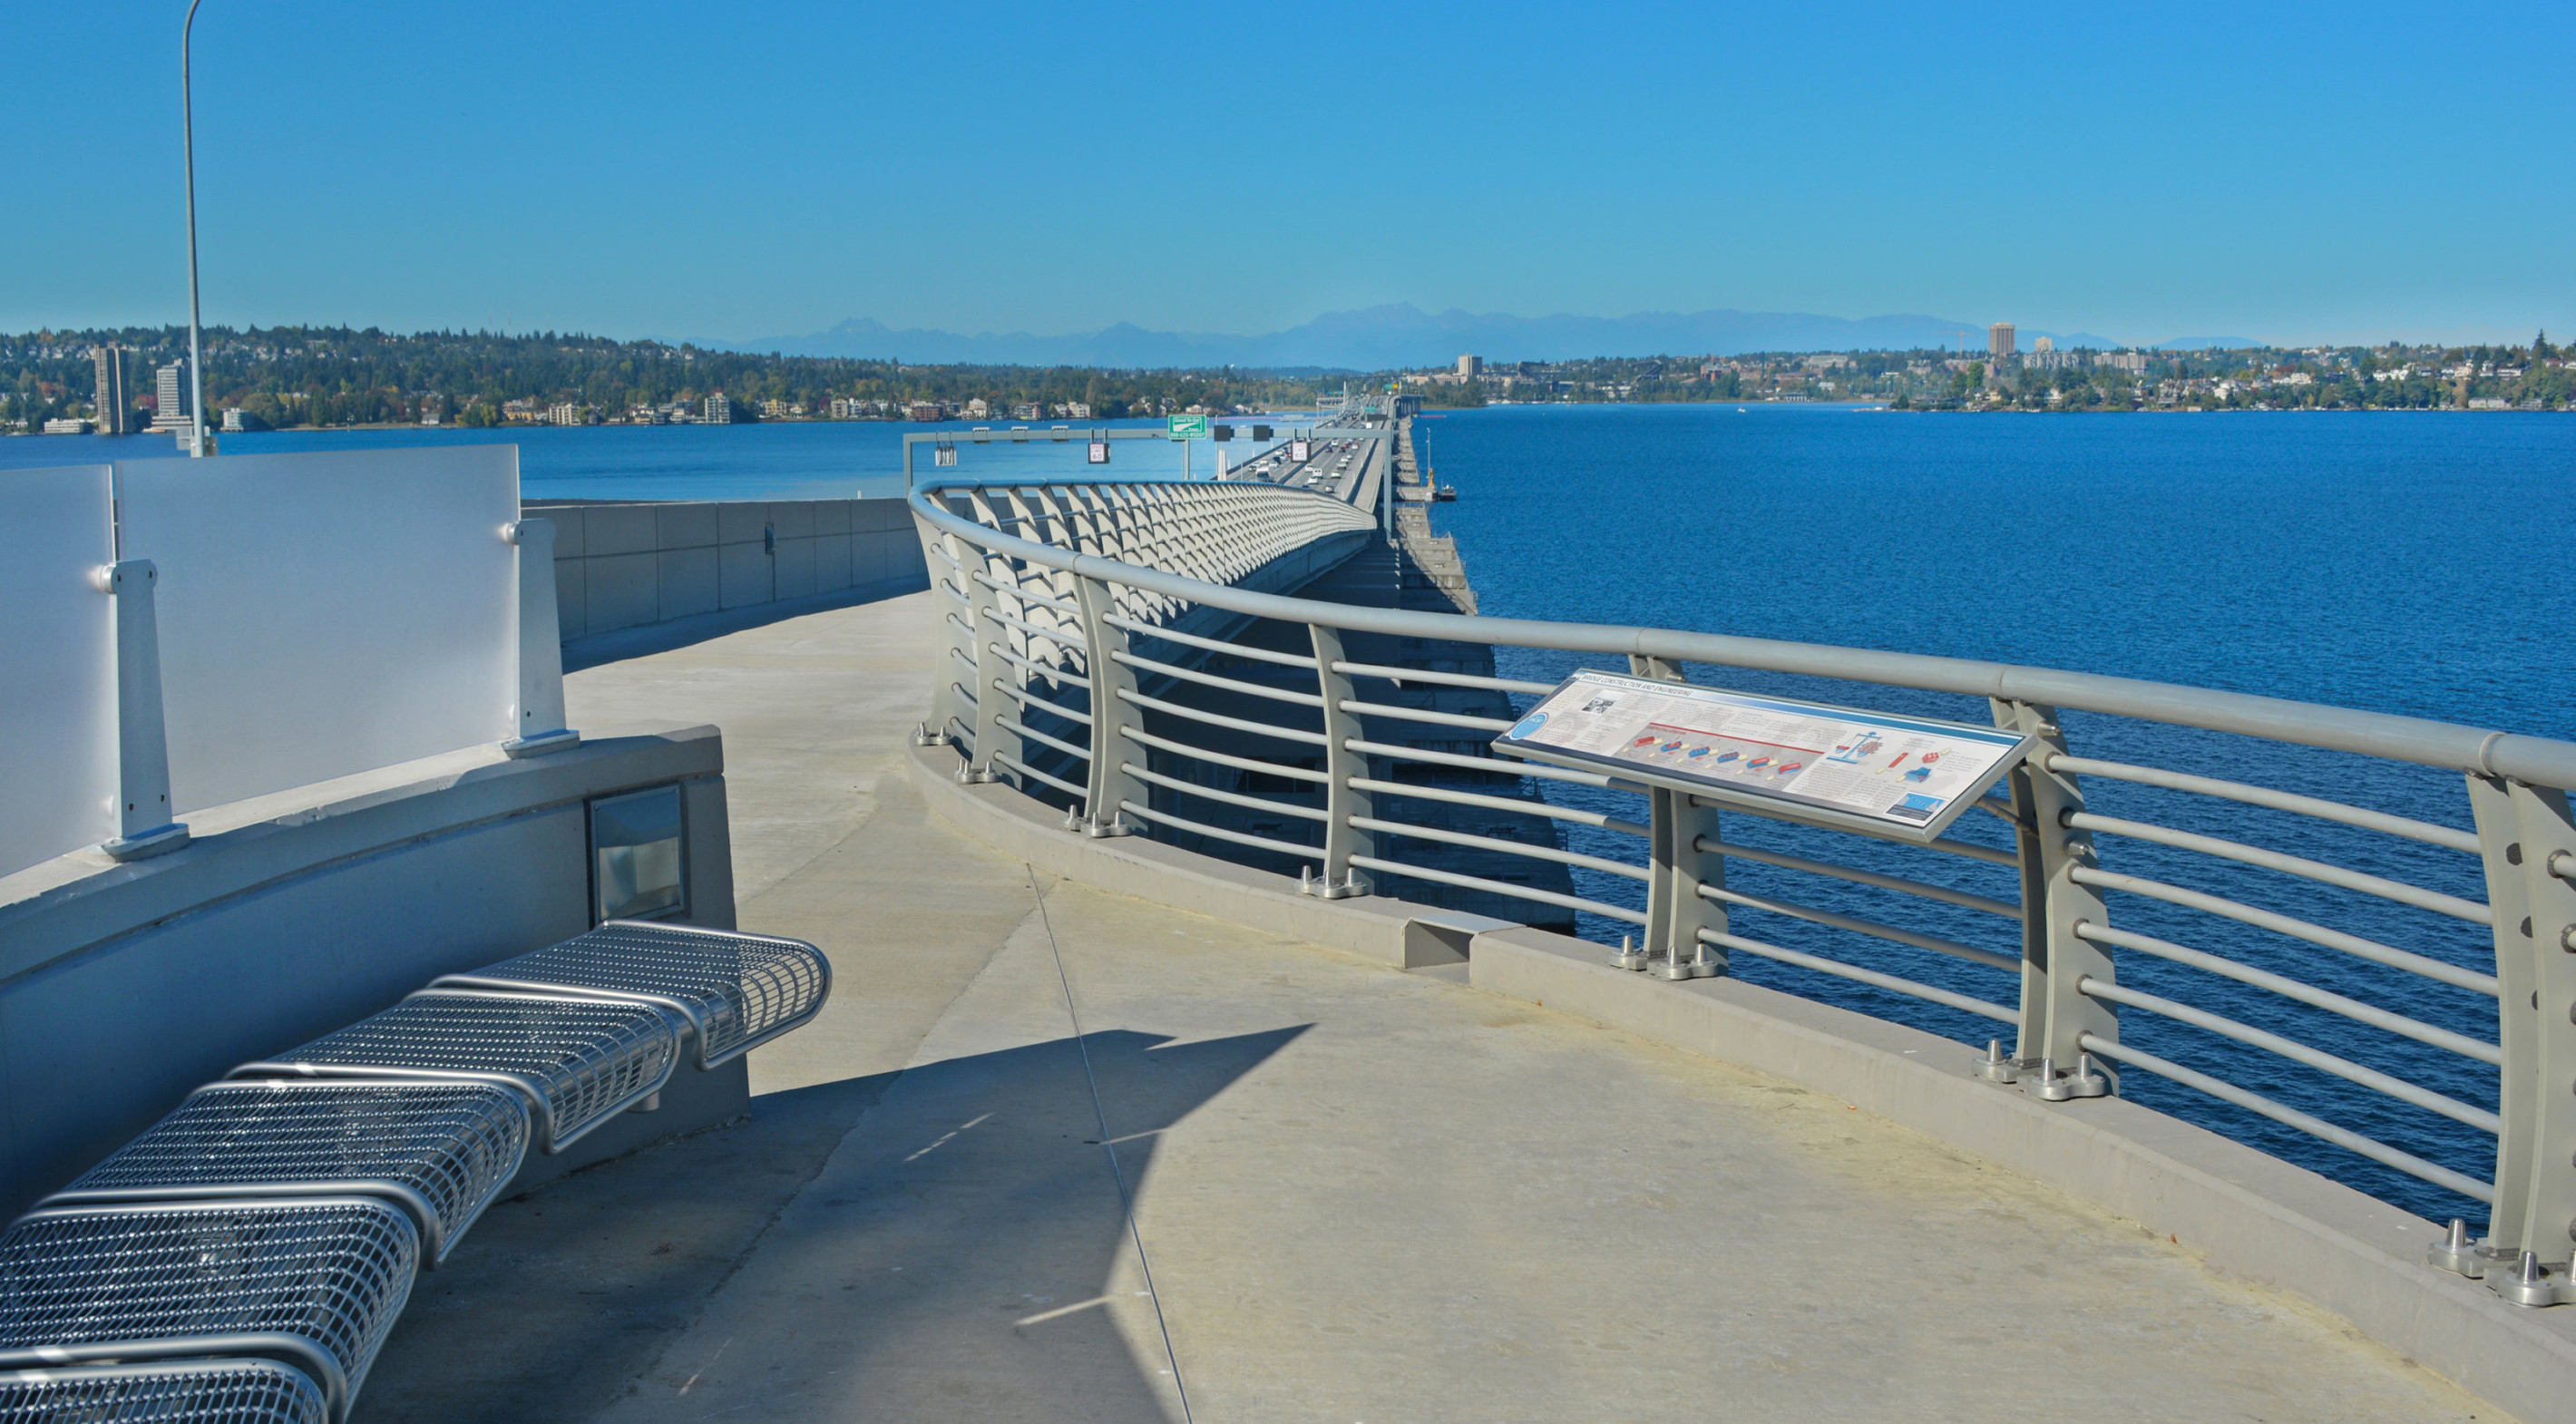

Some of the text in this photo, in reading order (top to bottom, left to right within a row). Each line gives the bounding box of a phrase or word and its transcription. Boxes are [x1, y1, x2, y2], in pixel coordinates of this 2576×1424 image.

[1582, 674, 1693, 697] BRIDGE CONSTRUCTION AND ENGINEERING
